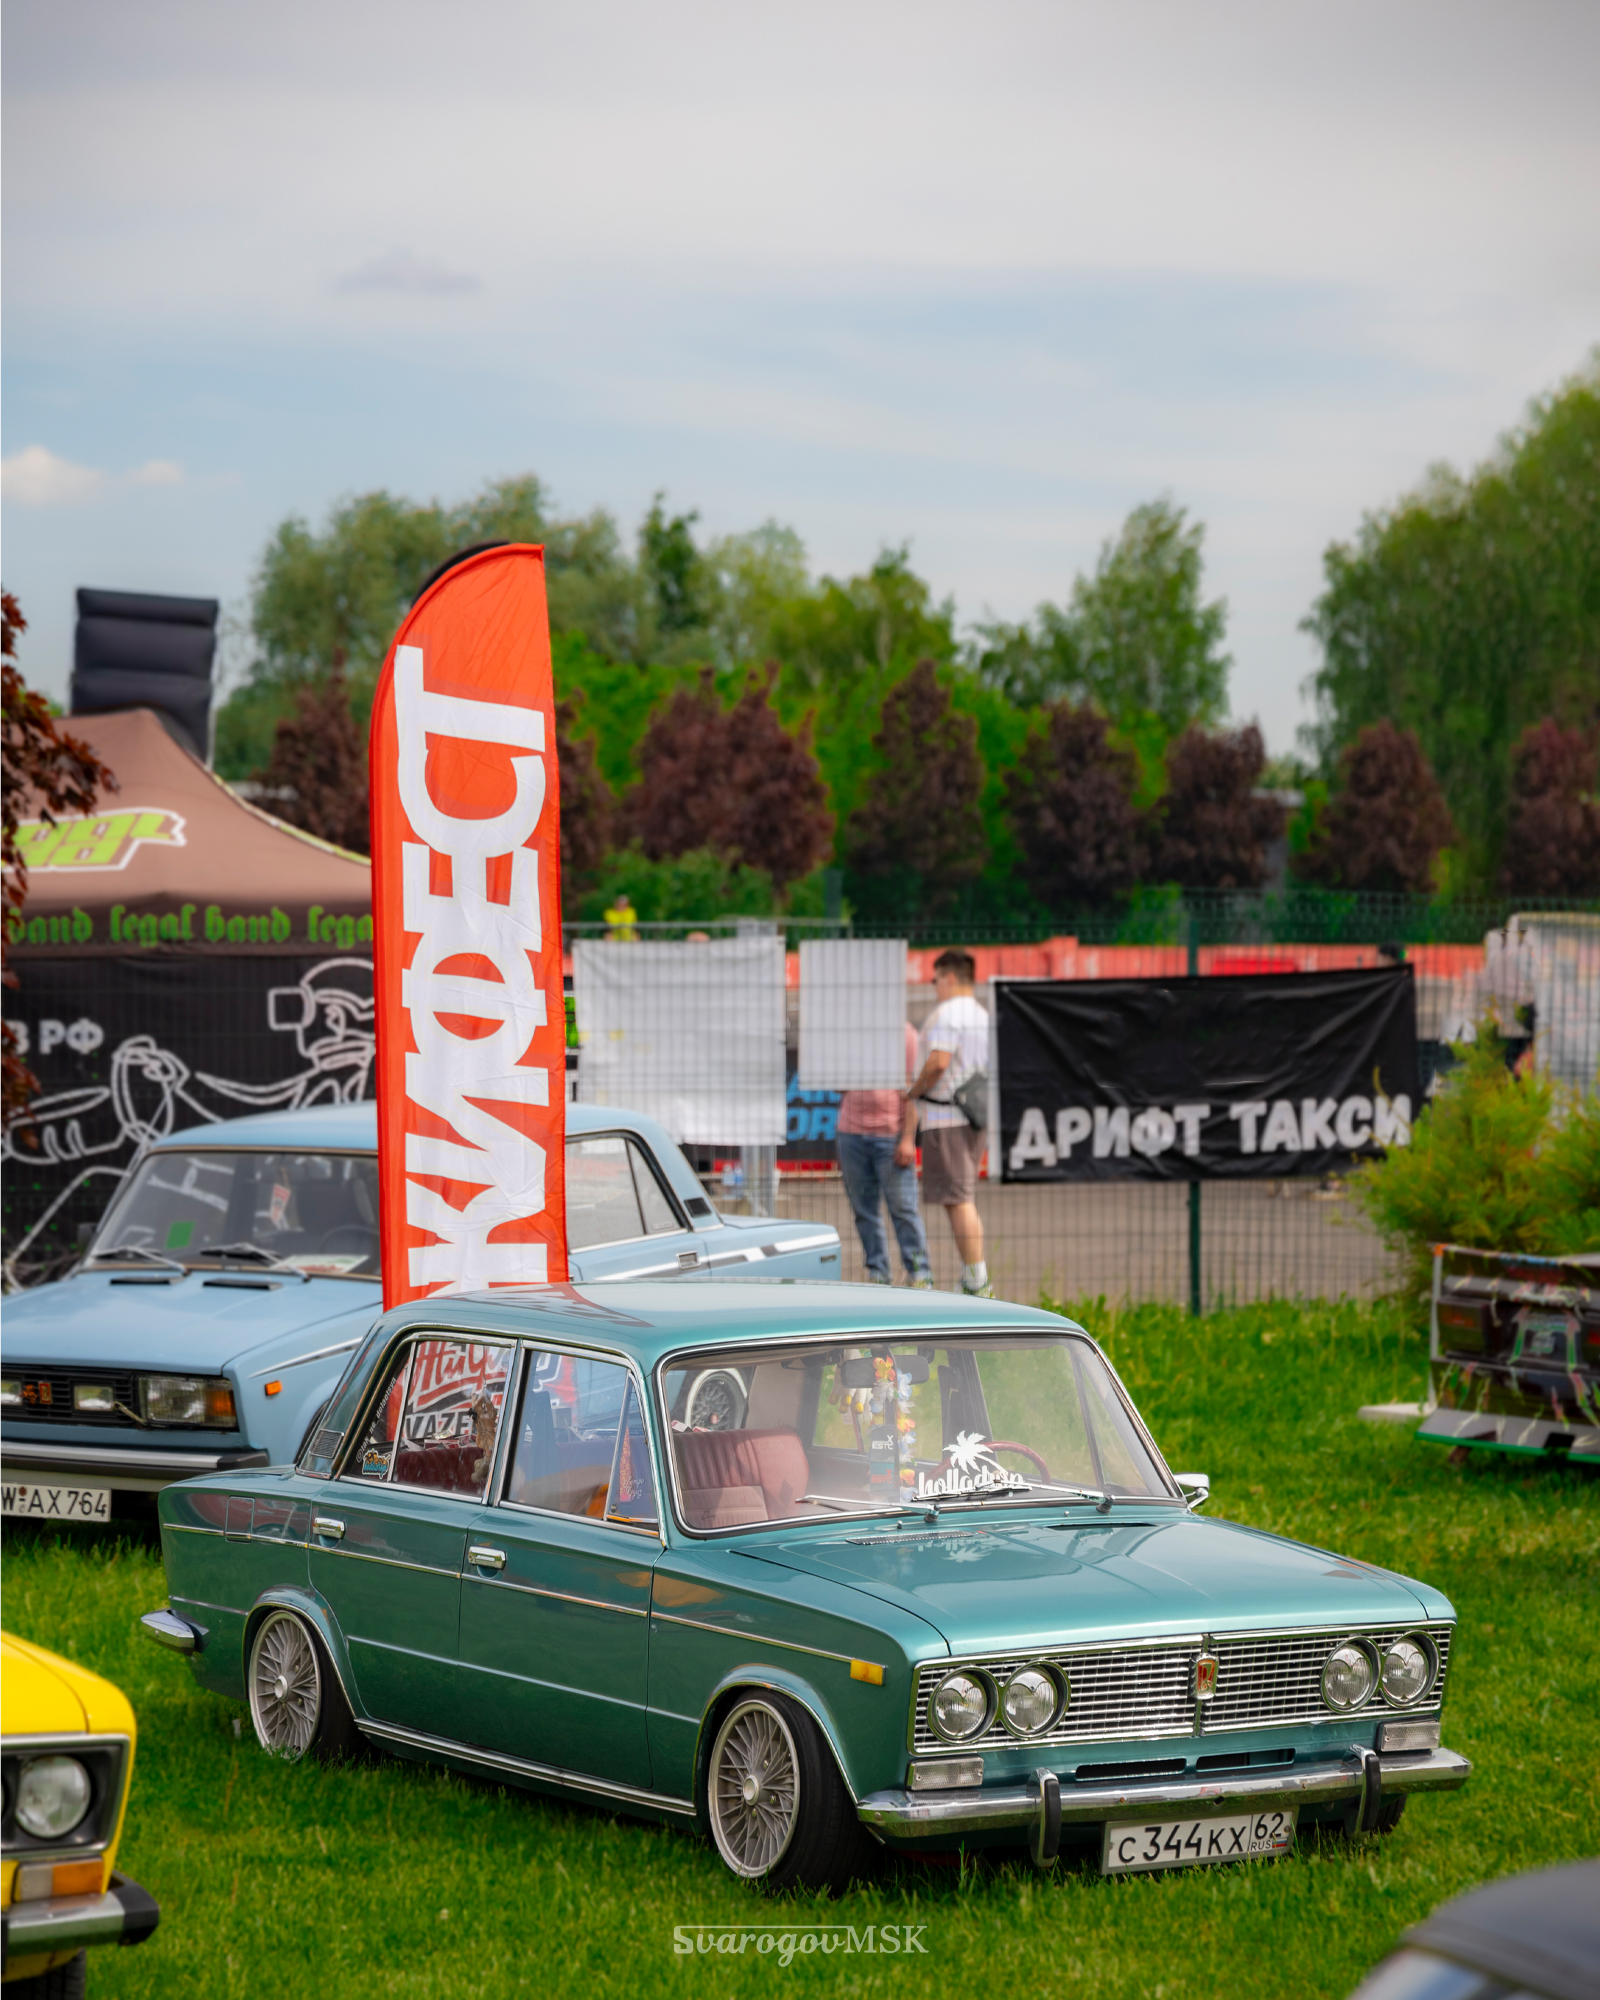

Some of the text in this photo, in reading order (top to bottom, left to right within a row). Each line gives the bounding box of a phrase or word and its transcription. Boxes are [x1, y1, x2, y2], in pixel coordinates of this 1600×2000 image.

[110, 903, 197, 947] legal
[205, 905, 291, 943] band
[39, 1017, 104, 1055] РФ
[1009, 1093, 1412, 1170] ДРИФТ ТАКСИ
[1253, 1812, 1285, 1840] 62
[1250, 1839, 1272, 1852] RUS
